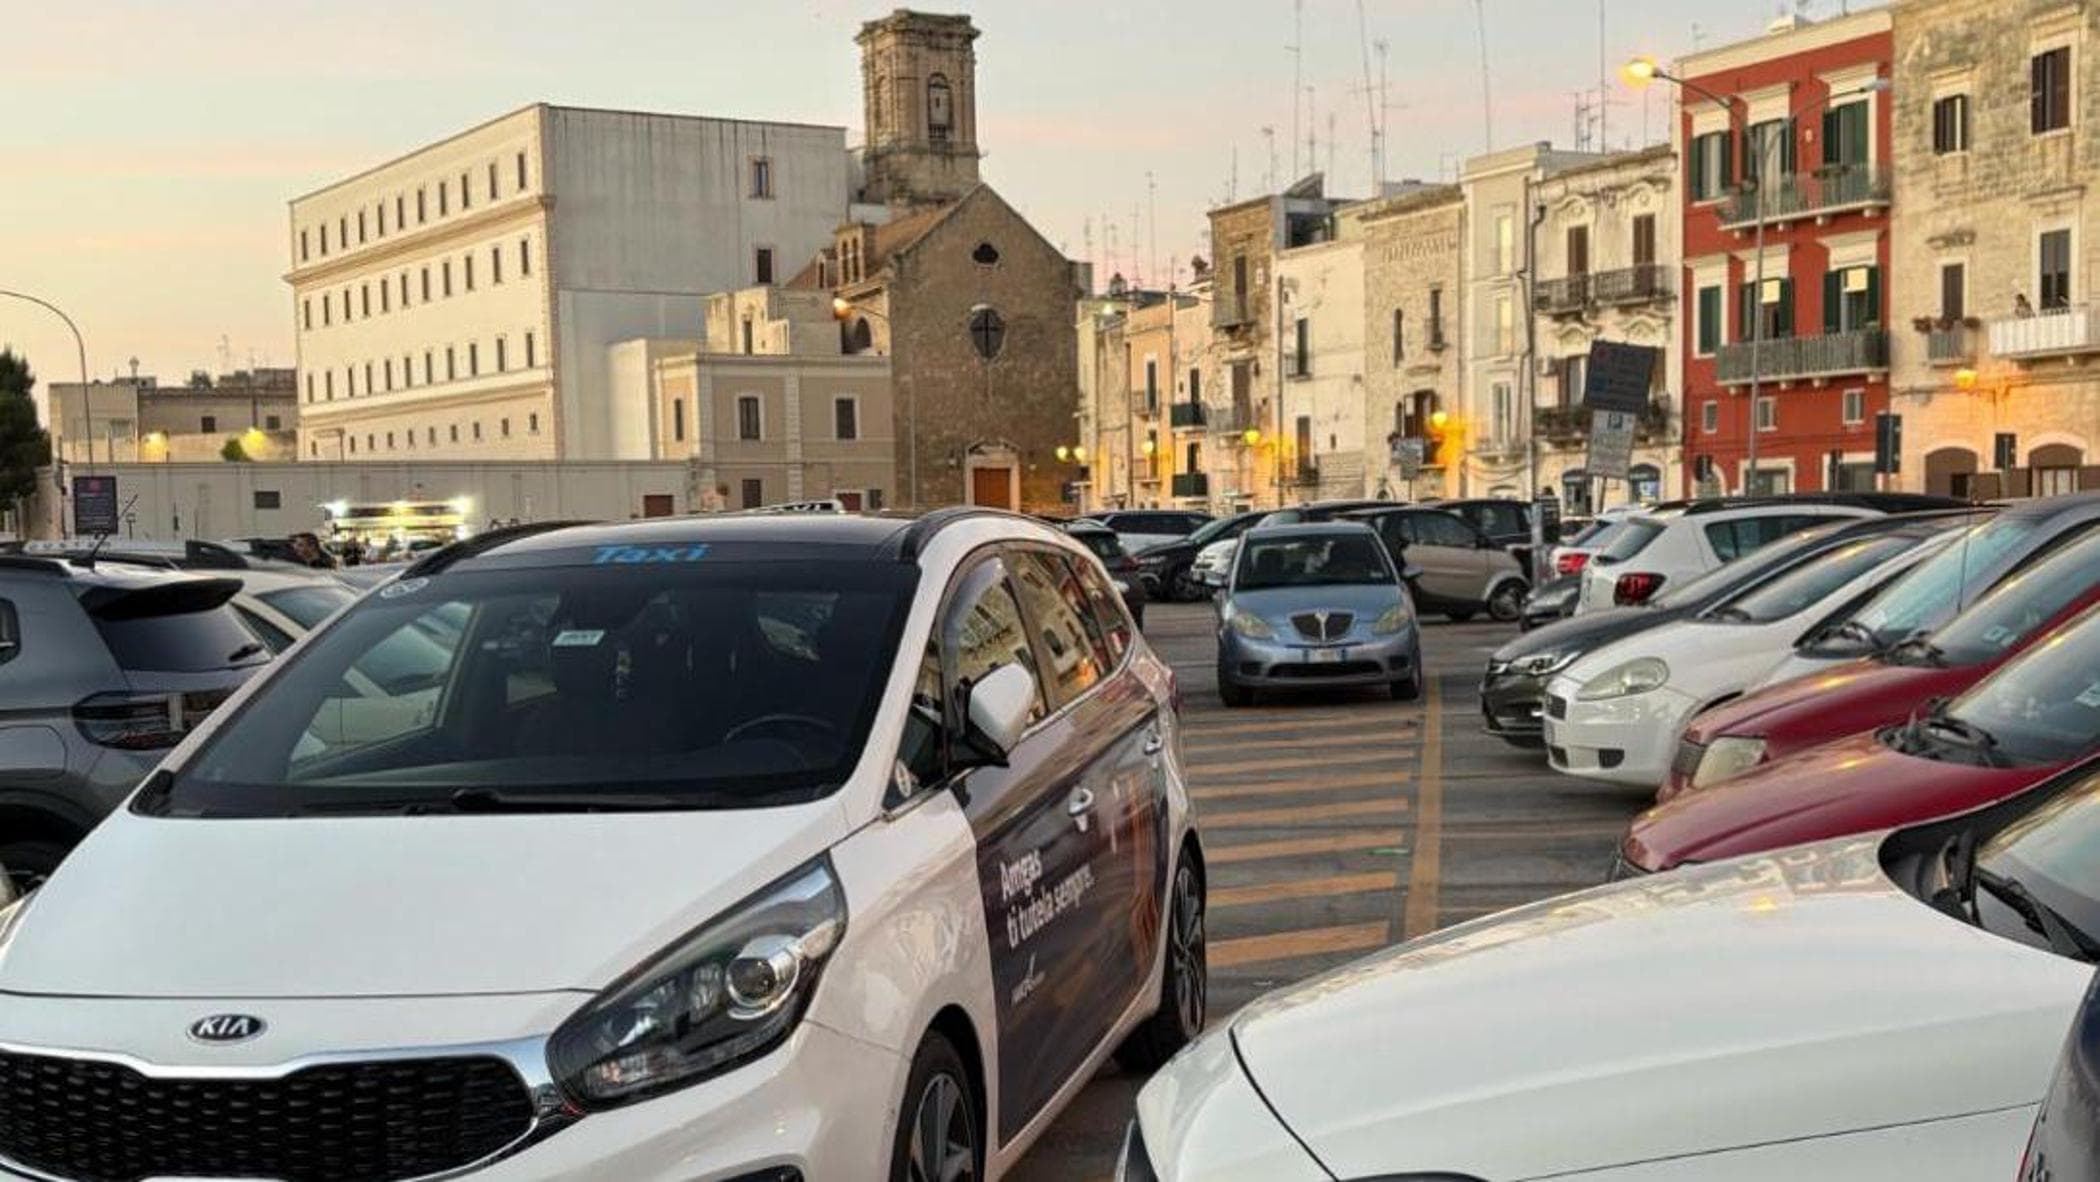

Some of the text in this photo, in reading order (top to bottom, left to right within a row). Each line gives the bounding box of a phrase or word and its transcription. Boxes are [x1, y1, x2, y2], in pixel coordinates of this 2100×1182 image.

[593, 542, 710, 564] Taxi
[1007, 904, 1019, 949] ti
[198, 1018, 249, 1035] KIA
